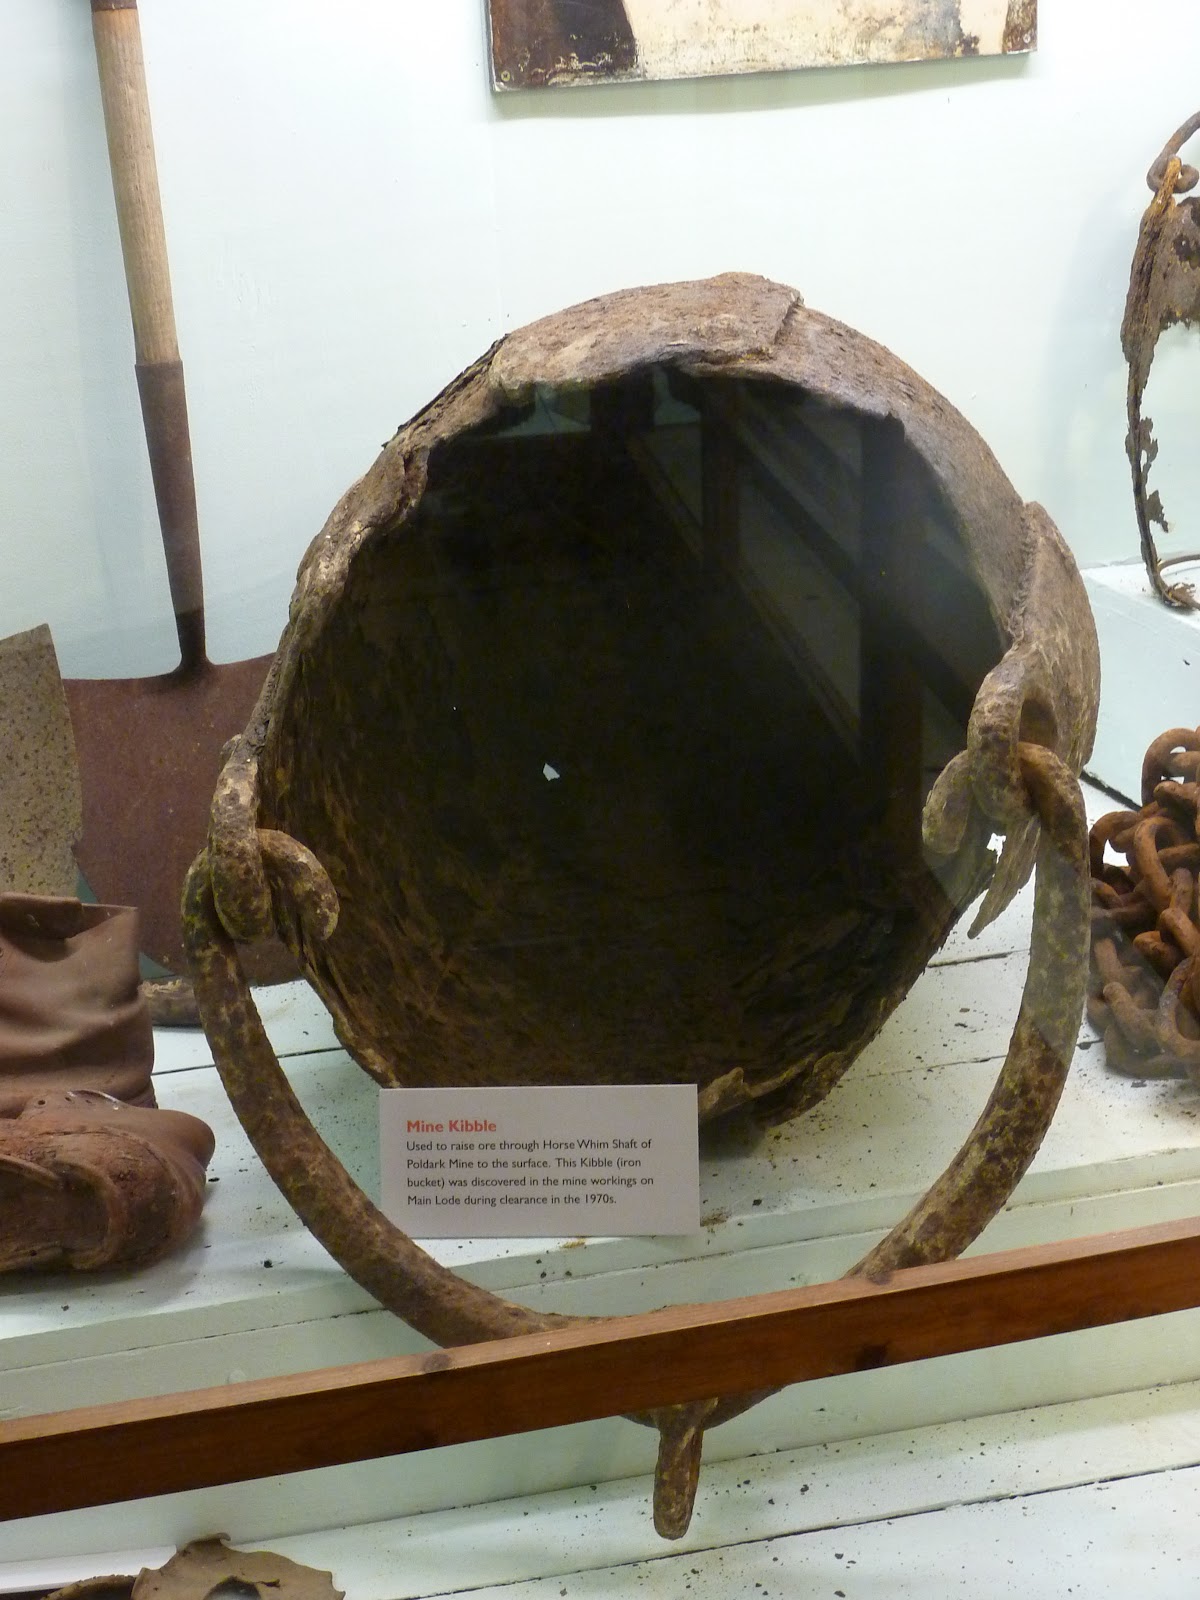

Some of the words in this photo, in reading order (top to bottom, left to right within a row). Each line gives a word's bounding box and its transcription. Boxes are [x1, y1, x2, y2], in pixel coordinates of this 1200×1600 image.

[407, 1120, 444, 1133] Mine
[448, 1120, 496, 1132] Kibble
[407, 1141, 432, 1152] Used
[436, 1142, 447, 1151] to
[451, 1141, 474, 1151] raise
[478, 1142, 496, 1151] ore
[500, 1140, 539, 1152] through
[544, 1140, 575, 1151] Horse
[577, 1139, 608, 1150] Whim
[612, 1138, 638, 1149] Shaft
[641, 1139, 652, 1149] of
[407, 1159, 445, 1170] Poldark
[449, 1159, 474, 1169] Mine
[478, 1160, 488, 1169] to
[492, 1158, 508, 1169] the
[512, 1158, 550, 1169] surface.
[555, 1158, 576, 1169] This
[581, 1157, 612, 1168] Kibble
[617, 1157, 641, 1170] (iron
[407, 1177, 444, 1190] bucket)
[448, 1179, 468, 1188] was
[471, 1176, 526, 1187] discovered
[530, 1177, 538, 1187] in
[542, 1176, 558, 1187] the
[562, 1176, 587, 1187] mine
[590, 1176, 637, 1188] workings
[641, 1177, 653, 1186] on
[408, 1196, 431, 1206] Main
[436, 1195, 460, 1206] Lode
[464, 1195, 496, 1207] during
[500, 1194, 547, 1205] clearance
[551, 1195, 560, 1205] in
[564, 1194, 580, 1205] the
[586, 1194, 616, 1205] 1970s.
